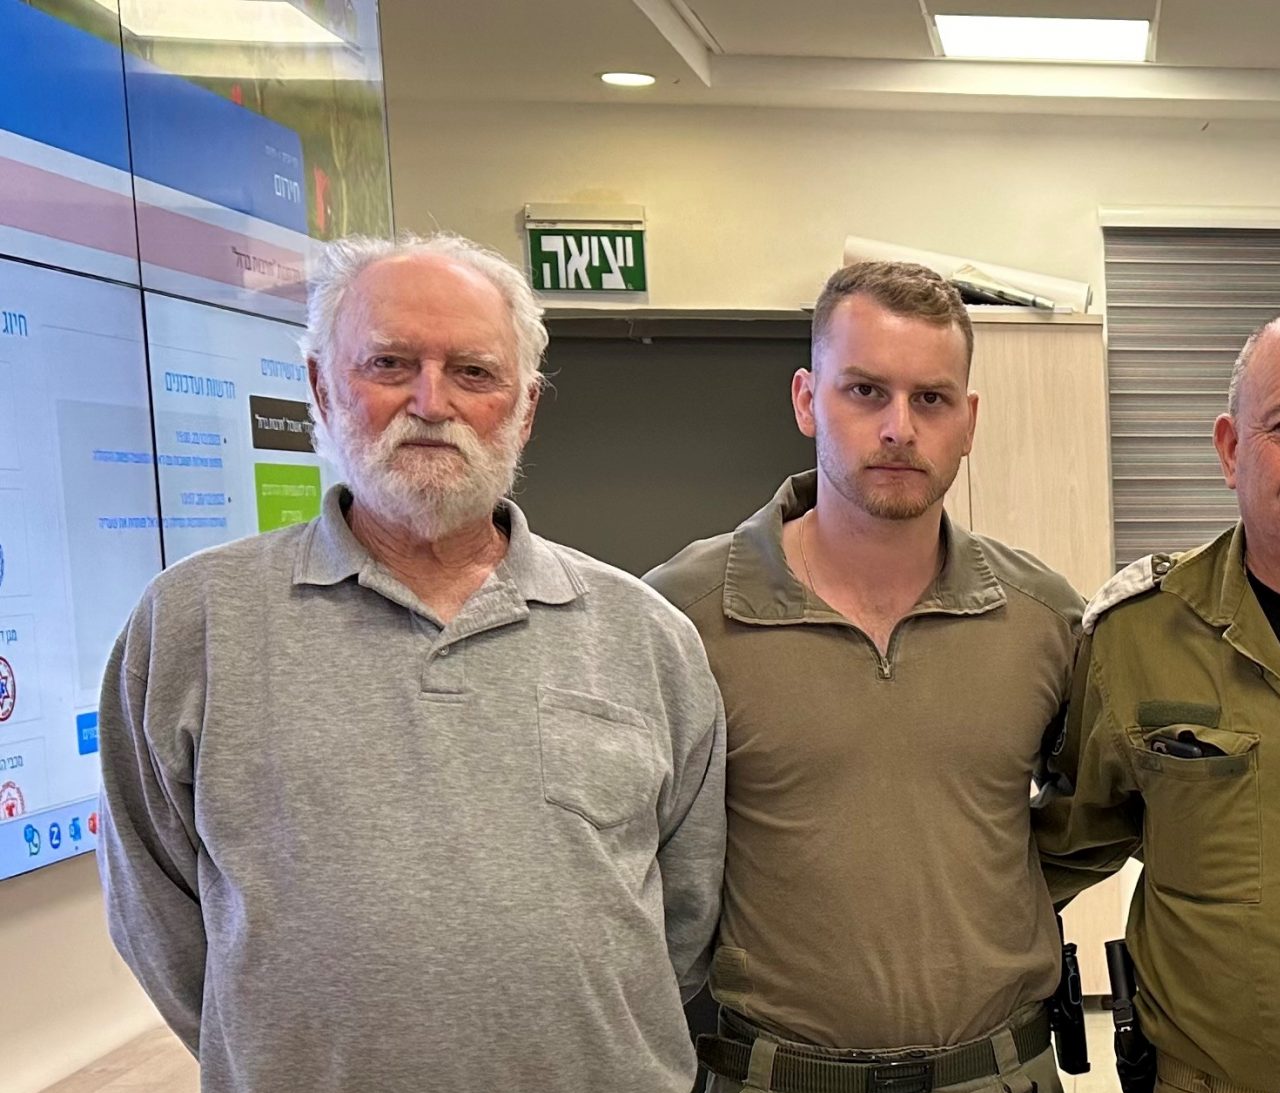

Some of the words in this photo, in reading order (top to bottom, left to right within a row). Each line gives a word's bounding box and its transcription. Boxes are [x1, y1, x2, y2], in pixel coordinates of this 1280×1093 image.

[541, 235, 634, 289] יציאה
[2, 311, 28, 337] חיוג
[206, 377, 236, 400] חדשות
